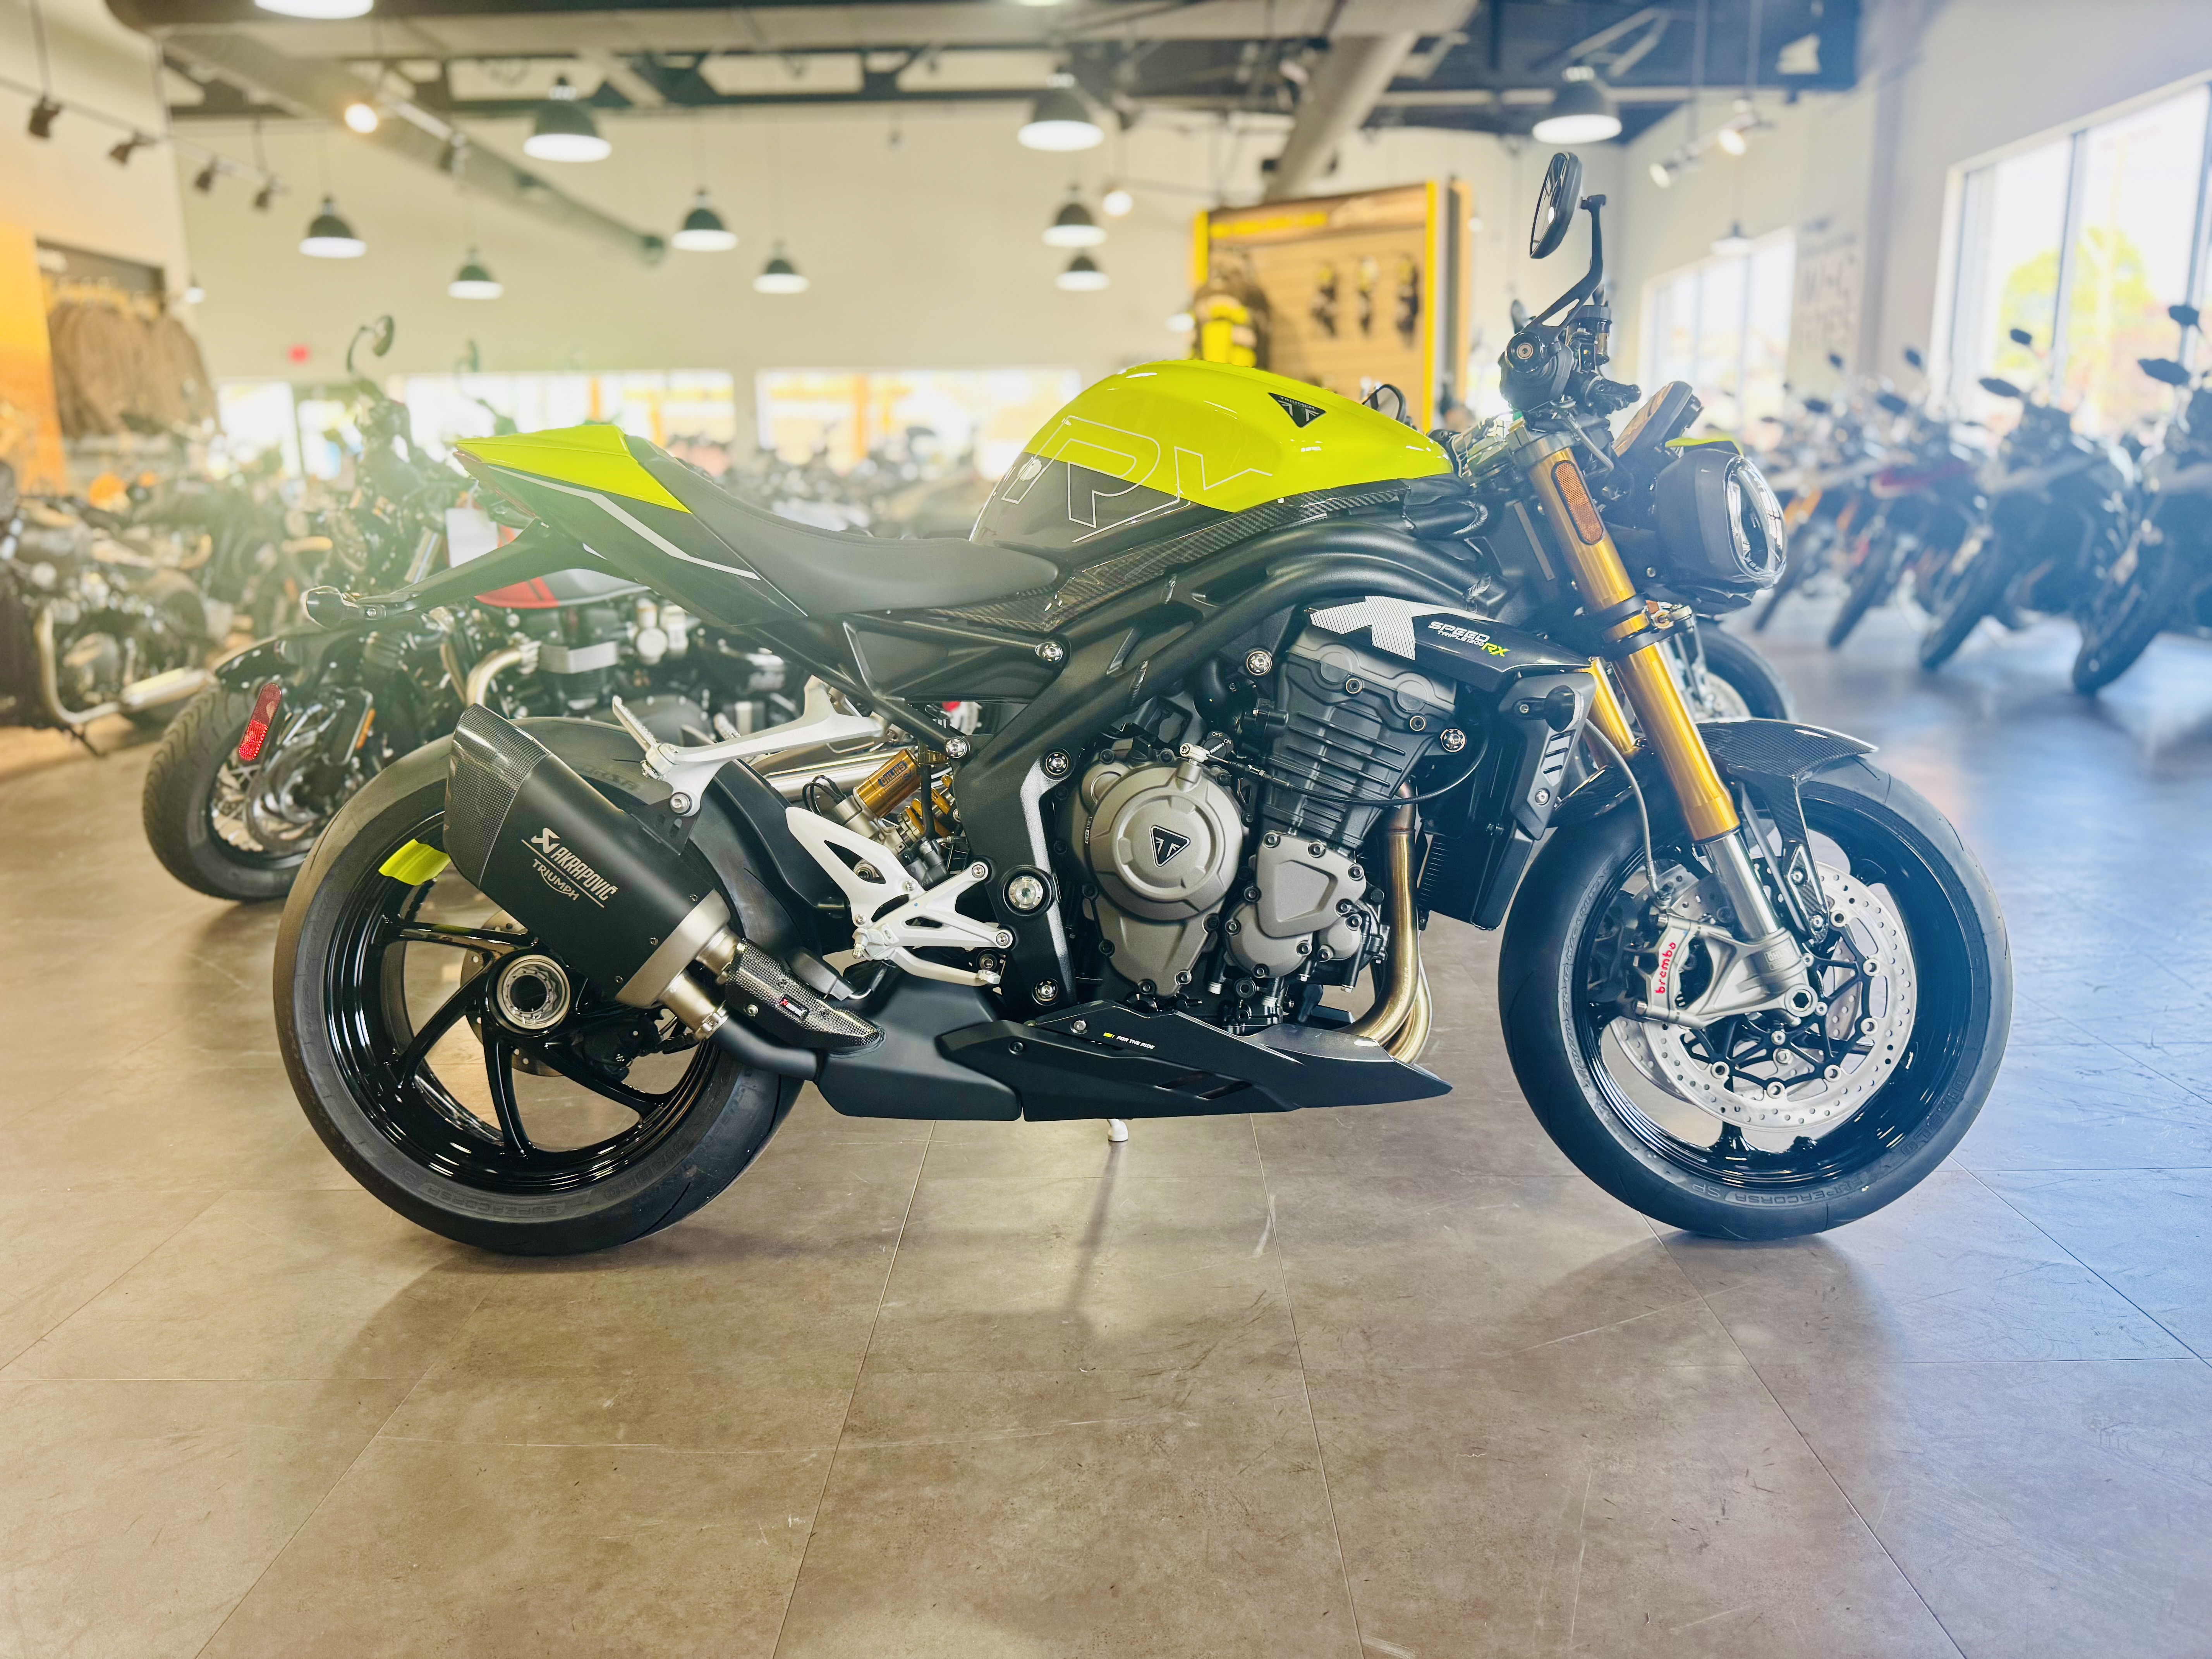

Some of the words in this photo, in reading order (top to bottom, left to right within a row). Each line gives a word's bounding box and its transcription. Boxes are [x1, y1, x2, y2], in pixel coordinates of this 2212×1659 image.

[1279, 396, 1315, 410] TRIUMPH
[1428, 621, 1490, 642] SPEED
[1481, 642, 1511, 657] RX
[532, 859, 579, 900] TRIUMPH
[1655, 942, 1676, 994] brembo
[1898, 1072, 1969, 1159] DIABLO
[1690, 1180, 1721, 1198] SP
[1733, 1175, 1865, 1205] SUPERCORSA
